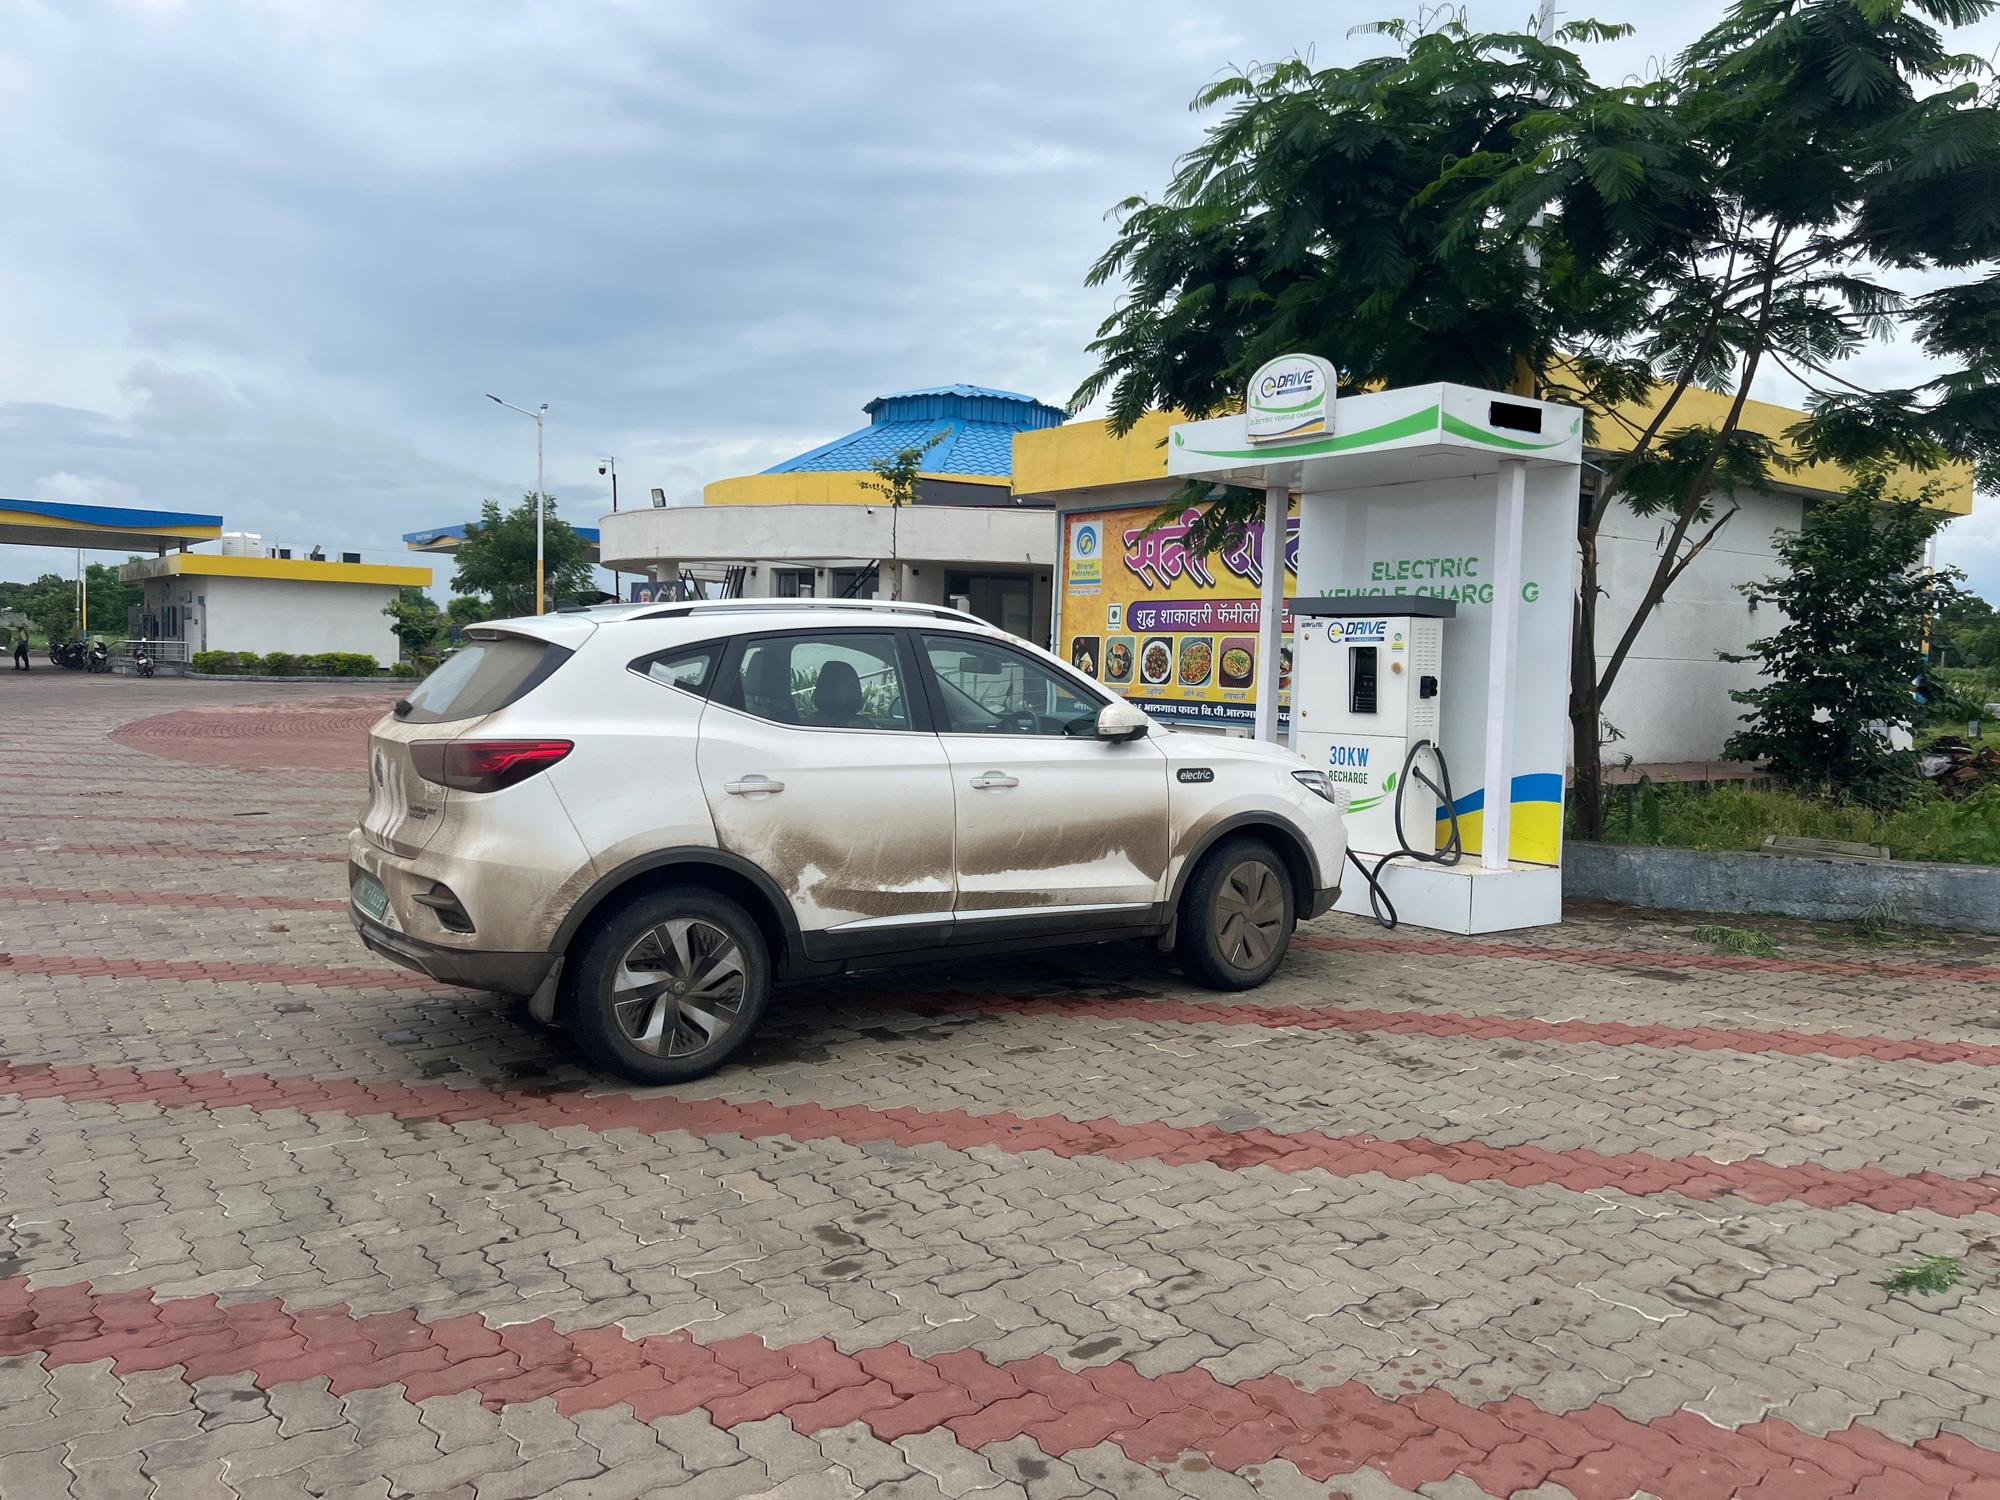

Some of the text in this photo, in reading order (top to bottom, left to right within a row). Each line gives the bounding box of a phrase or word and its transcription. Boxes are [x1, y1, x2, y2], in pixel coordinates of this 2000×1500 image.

[1371, 557, 1479, 581] ELECTRIC
[1136, 608, 1157, 630] शुद्ध
[1160, 602, 1213, 627] शाकाहारी
[1217, 602, 1260, 624] फॅमीली
[1329, 746, 1369, 767] 30KW
[1180, 770, 1211, 780] electric
[1328, 770, 1369, 785] RECHARGE
